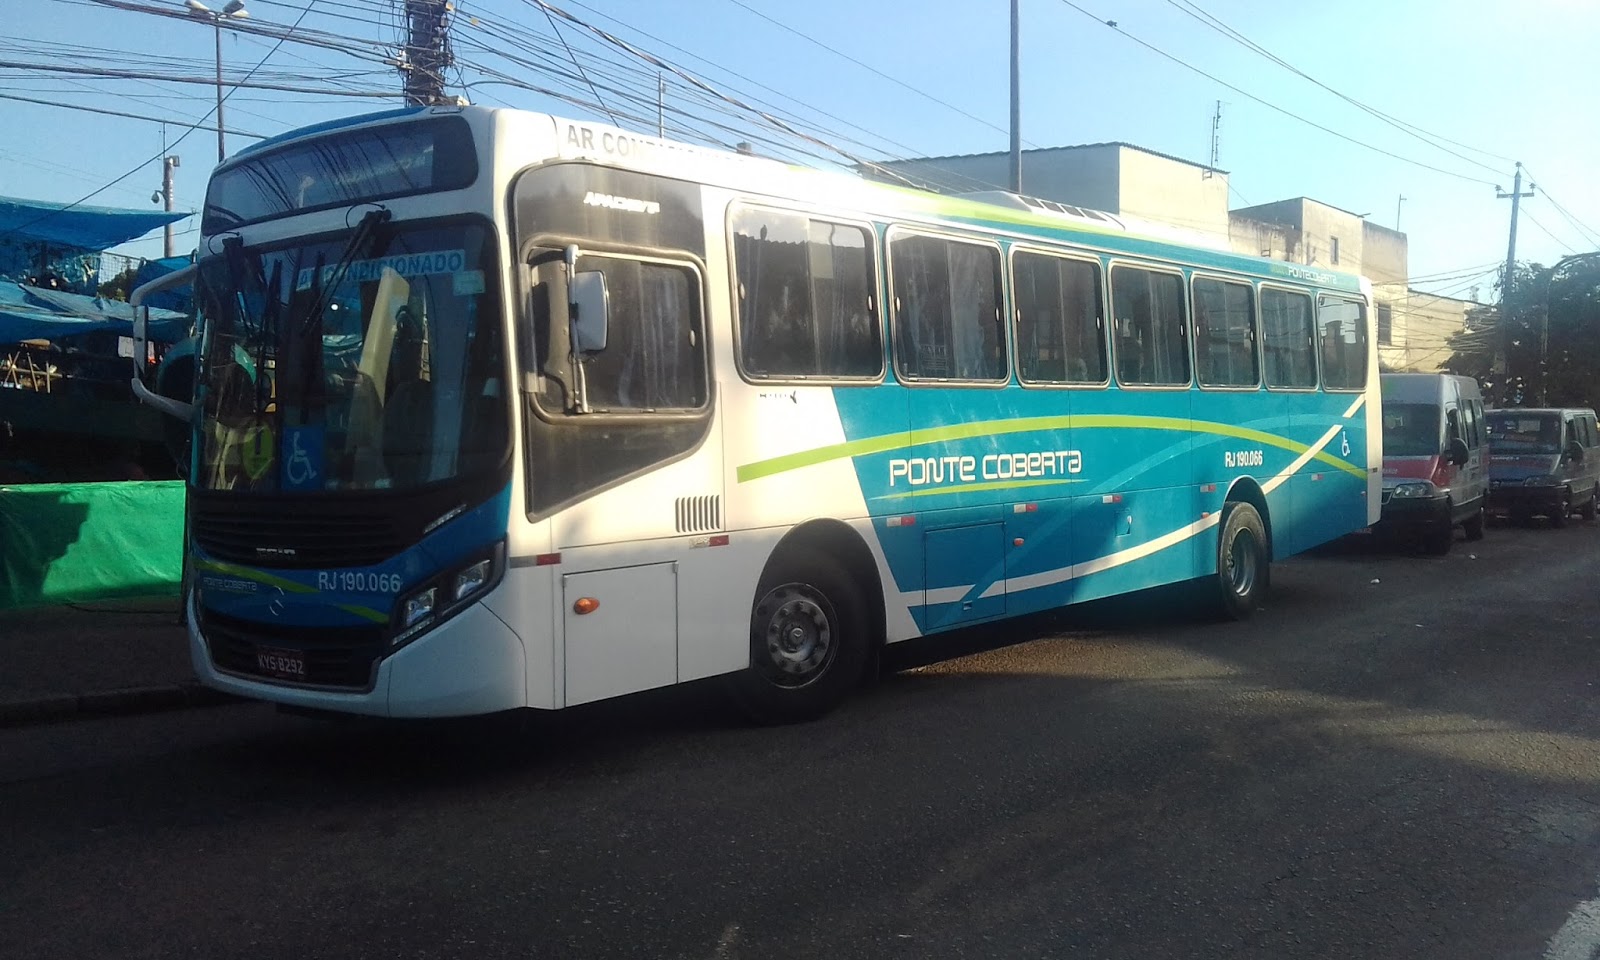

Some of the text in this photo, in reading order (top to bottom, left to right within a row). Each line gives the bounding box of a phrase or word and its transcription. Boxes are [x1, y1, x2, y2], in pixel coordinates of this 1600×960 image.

[567, 124, 594, 151] AR
[323, 252, 463, 284] CNDICONADO
[889, 450, 1082, 487] PONTE COBERTA
[1224, 450, 1263, 468] RJ 190.066
[318, 571, 401, 593] RJ 190.066
